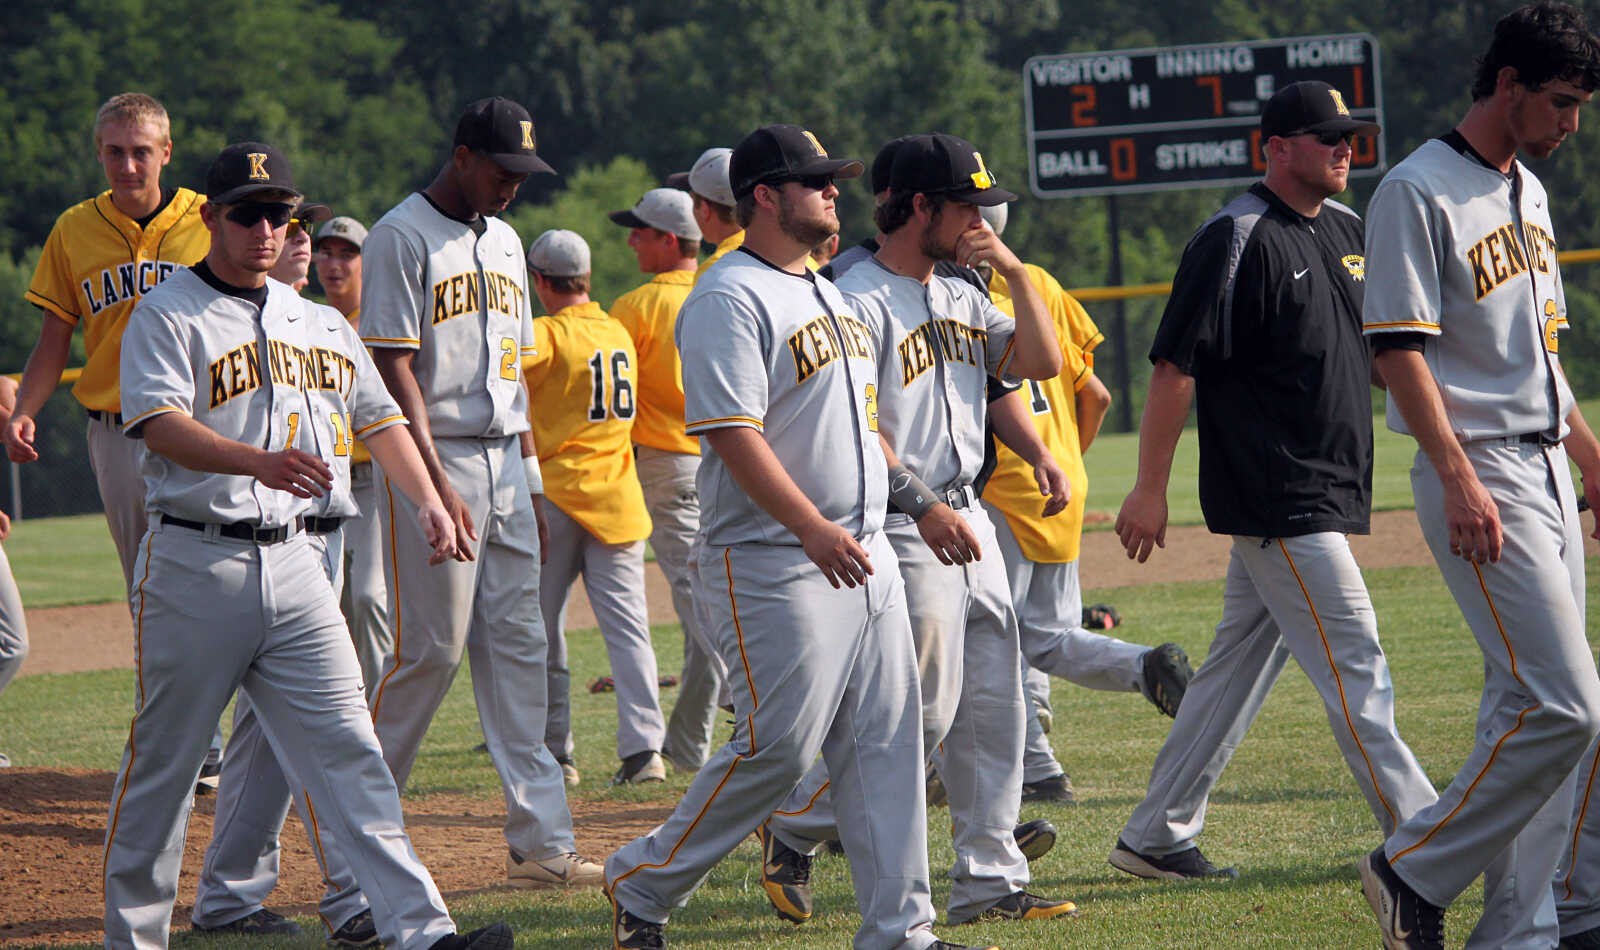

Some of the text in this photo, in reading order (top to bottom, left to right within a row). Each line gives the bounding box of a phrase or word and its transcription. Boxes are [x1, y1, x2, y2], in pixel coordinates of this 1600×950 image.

[1031, 38, 1365, 86] VISITOR INNING HOME
[1071, 84, 1097, 127] 2
[1129, 83, 1150, 109] H
[1196, 76, 1223, 117] 7
[1255, 74, 1275, 99] E
[1328, 89, 1350, 116] K
[520, 120, 535, 150] K
[247, 153, 270, 180] K
[1037, 150, 1107, 179] BALL
[1111, 138, 1137, 181] 0
[1155, 138, 1248, 170] STRIKE
[82, 260, 178, 316] LANCE
[208, 338, 306, 411] KENNET
[500, 337, 517, 382] 2
[588, 349, 637, 422] 16
